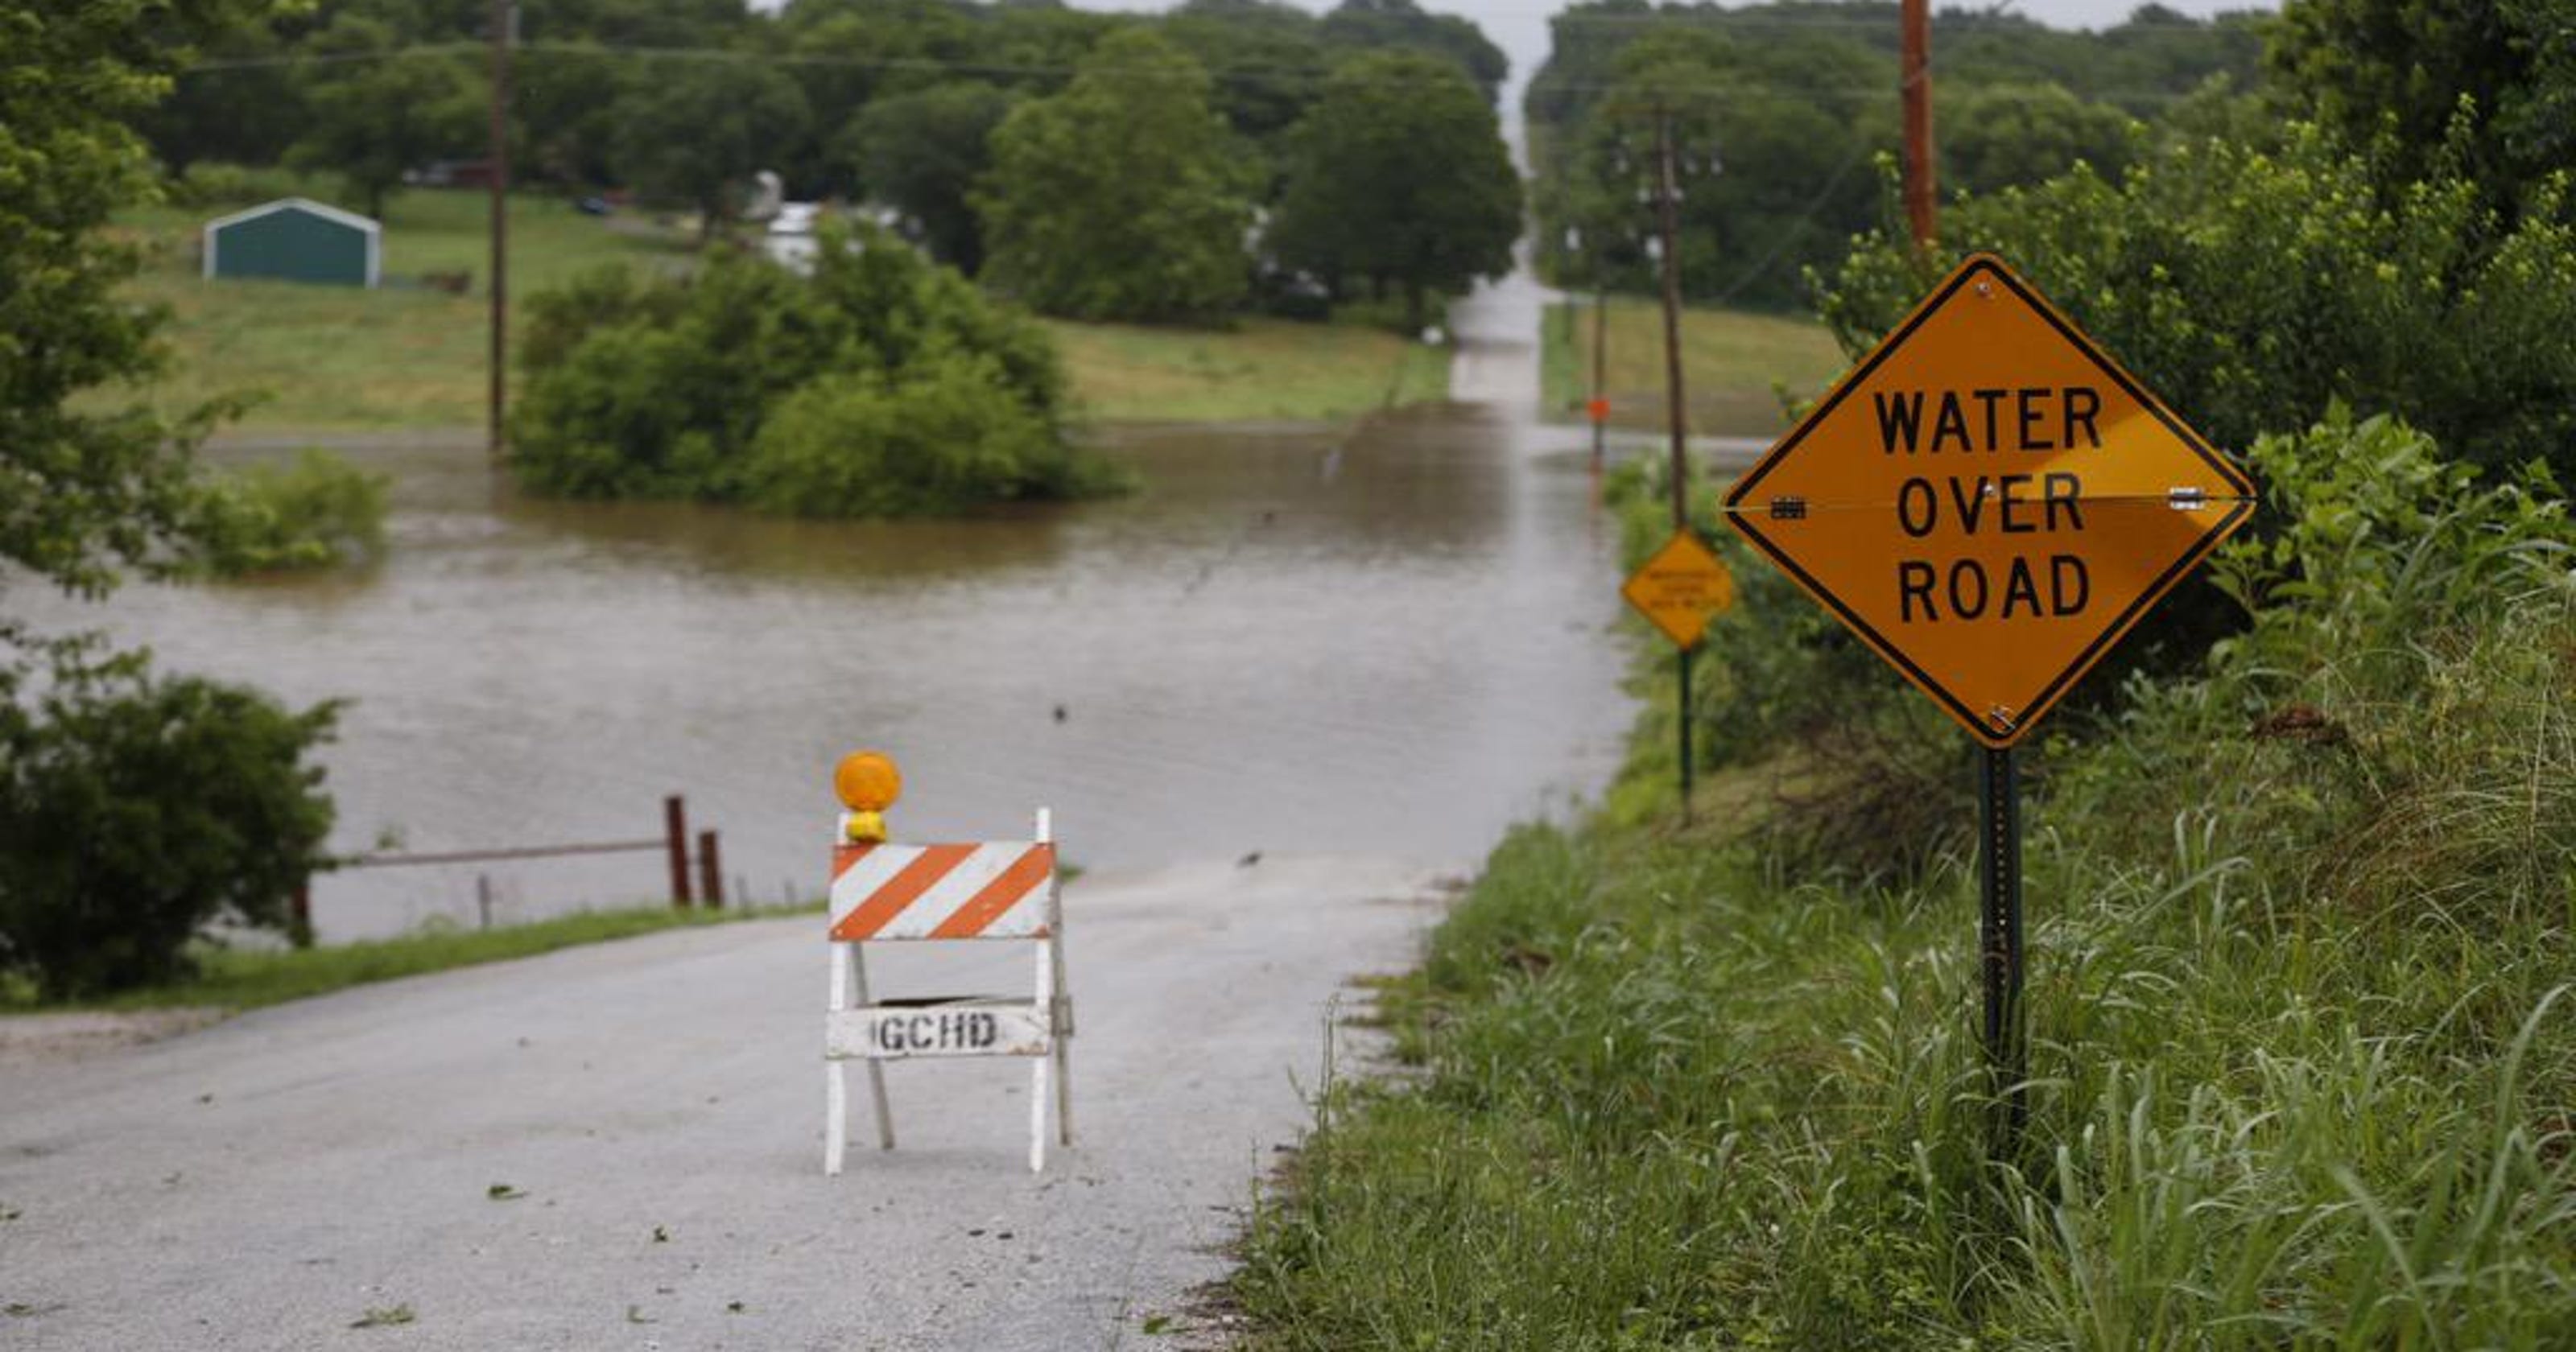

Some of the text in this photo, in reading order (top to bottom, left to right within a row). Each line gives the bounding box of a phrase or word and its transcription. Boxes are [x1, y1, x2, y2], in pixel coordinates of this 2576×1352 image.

[1874, 387, 2101, 454] WATER
[1898, 472, 2083, 538] OVER
[1899, 554, 2089, 623] ROAD
